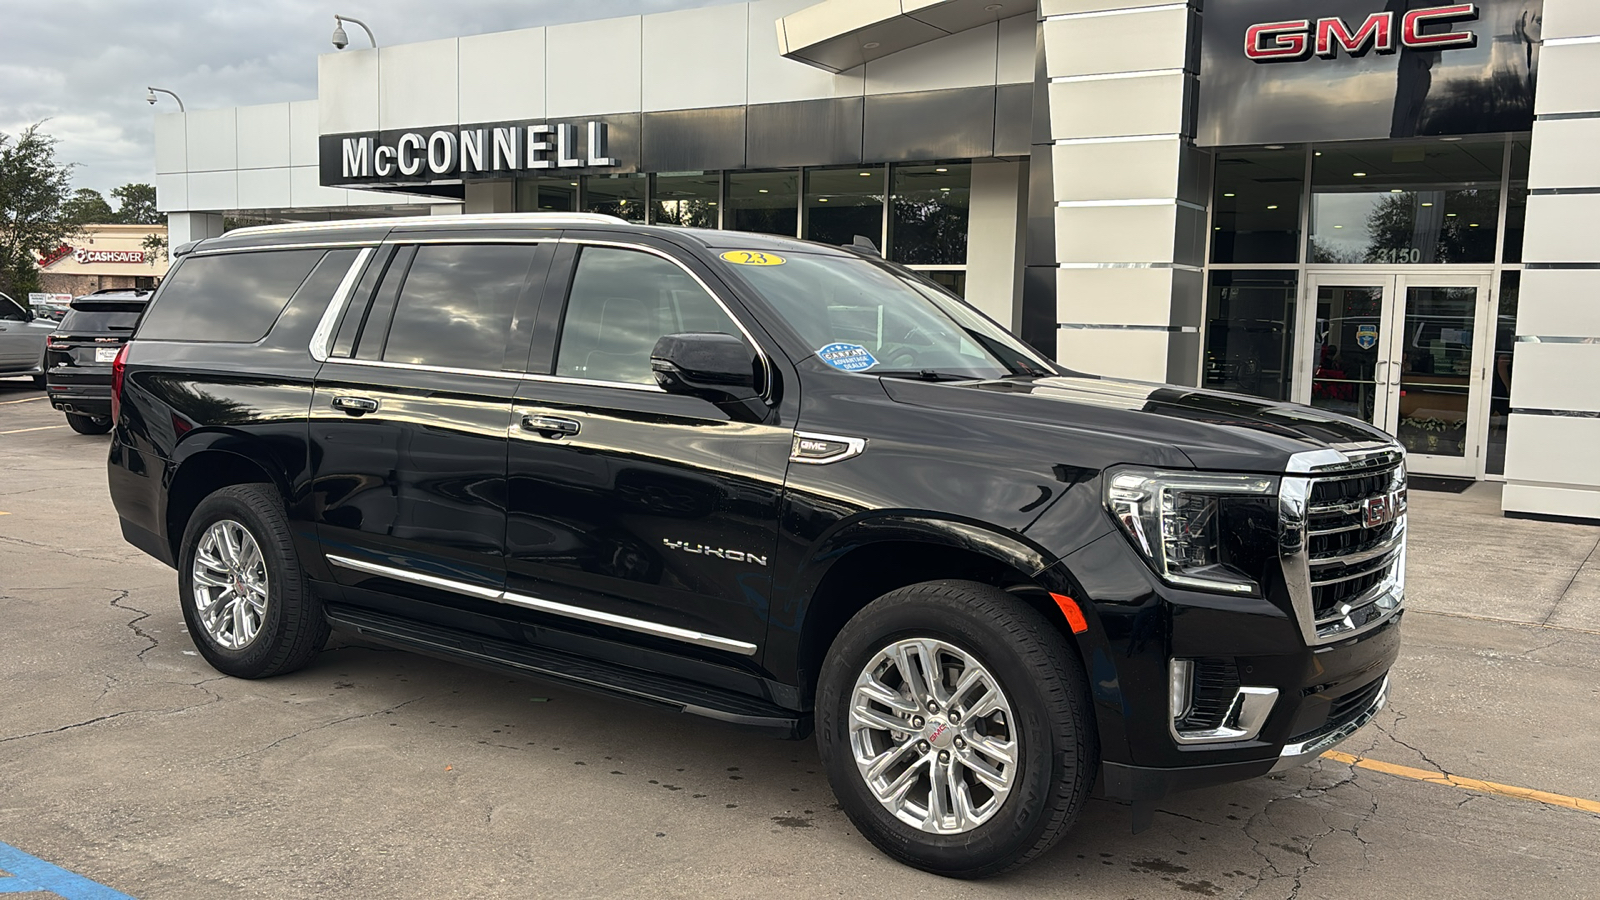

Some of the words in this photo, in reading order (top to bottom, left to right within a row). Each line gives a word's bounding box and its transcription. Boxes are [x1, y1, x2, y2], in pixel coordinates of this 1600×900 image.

[1245, 3, 1478, 62] GMC
[740, 252, 767, 264] 23
[1377, 248, 1420, 263] 3150
[843, 361, 869, 370] DEALER
[800, 440, 827, 450] GMC
[1362, 490, 1406, 529] GMC
[663, 538, 767, 566] YUKON
[929, 723, 947, 743] GMC
